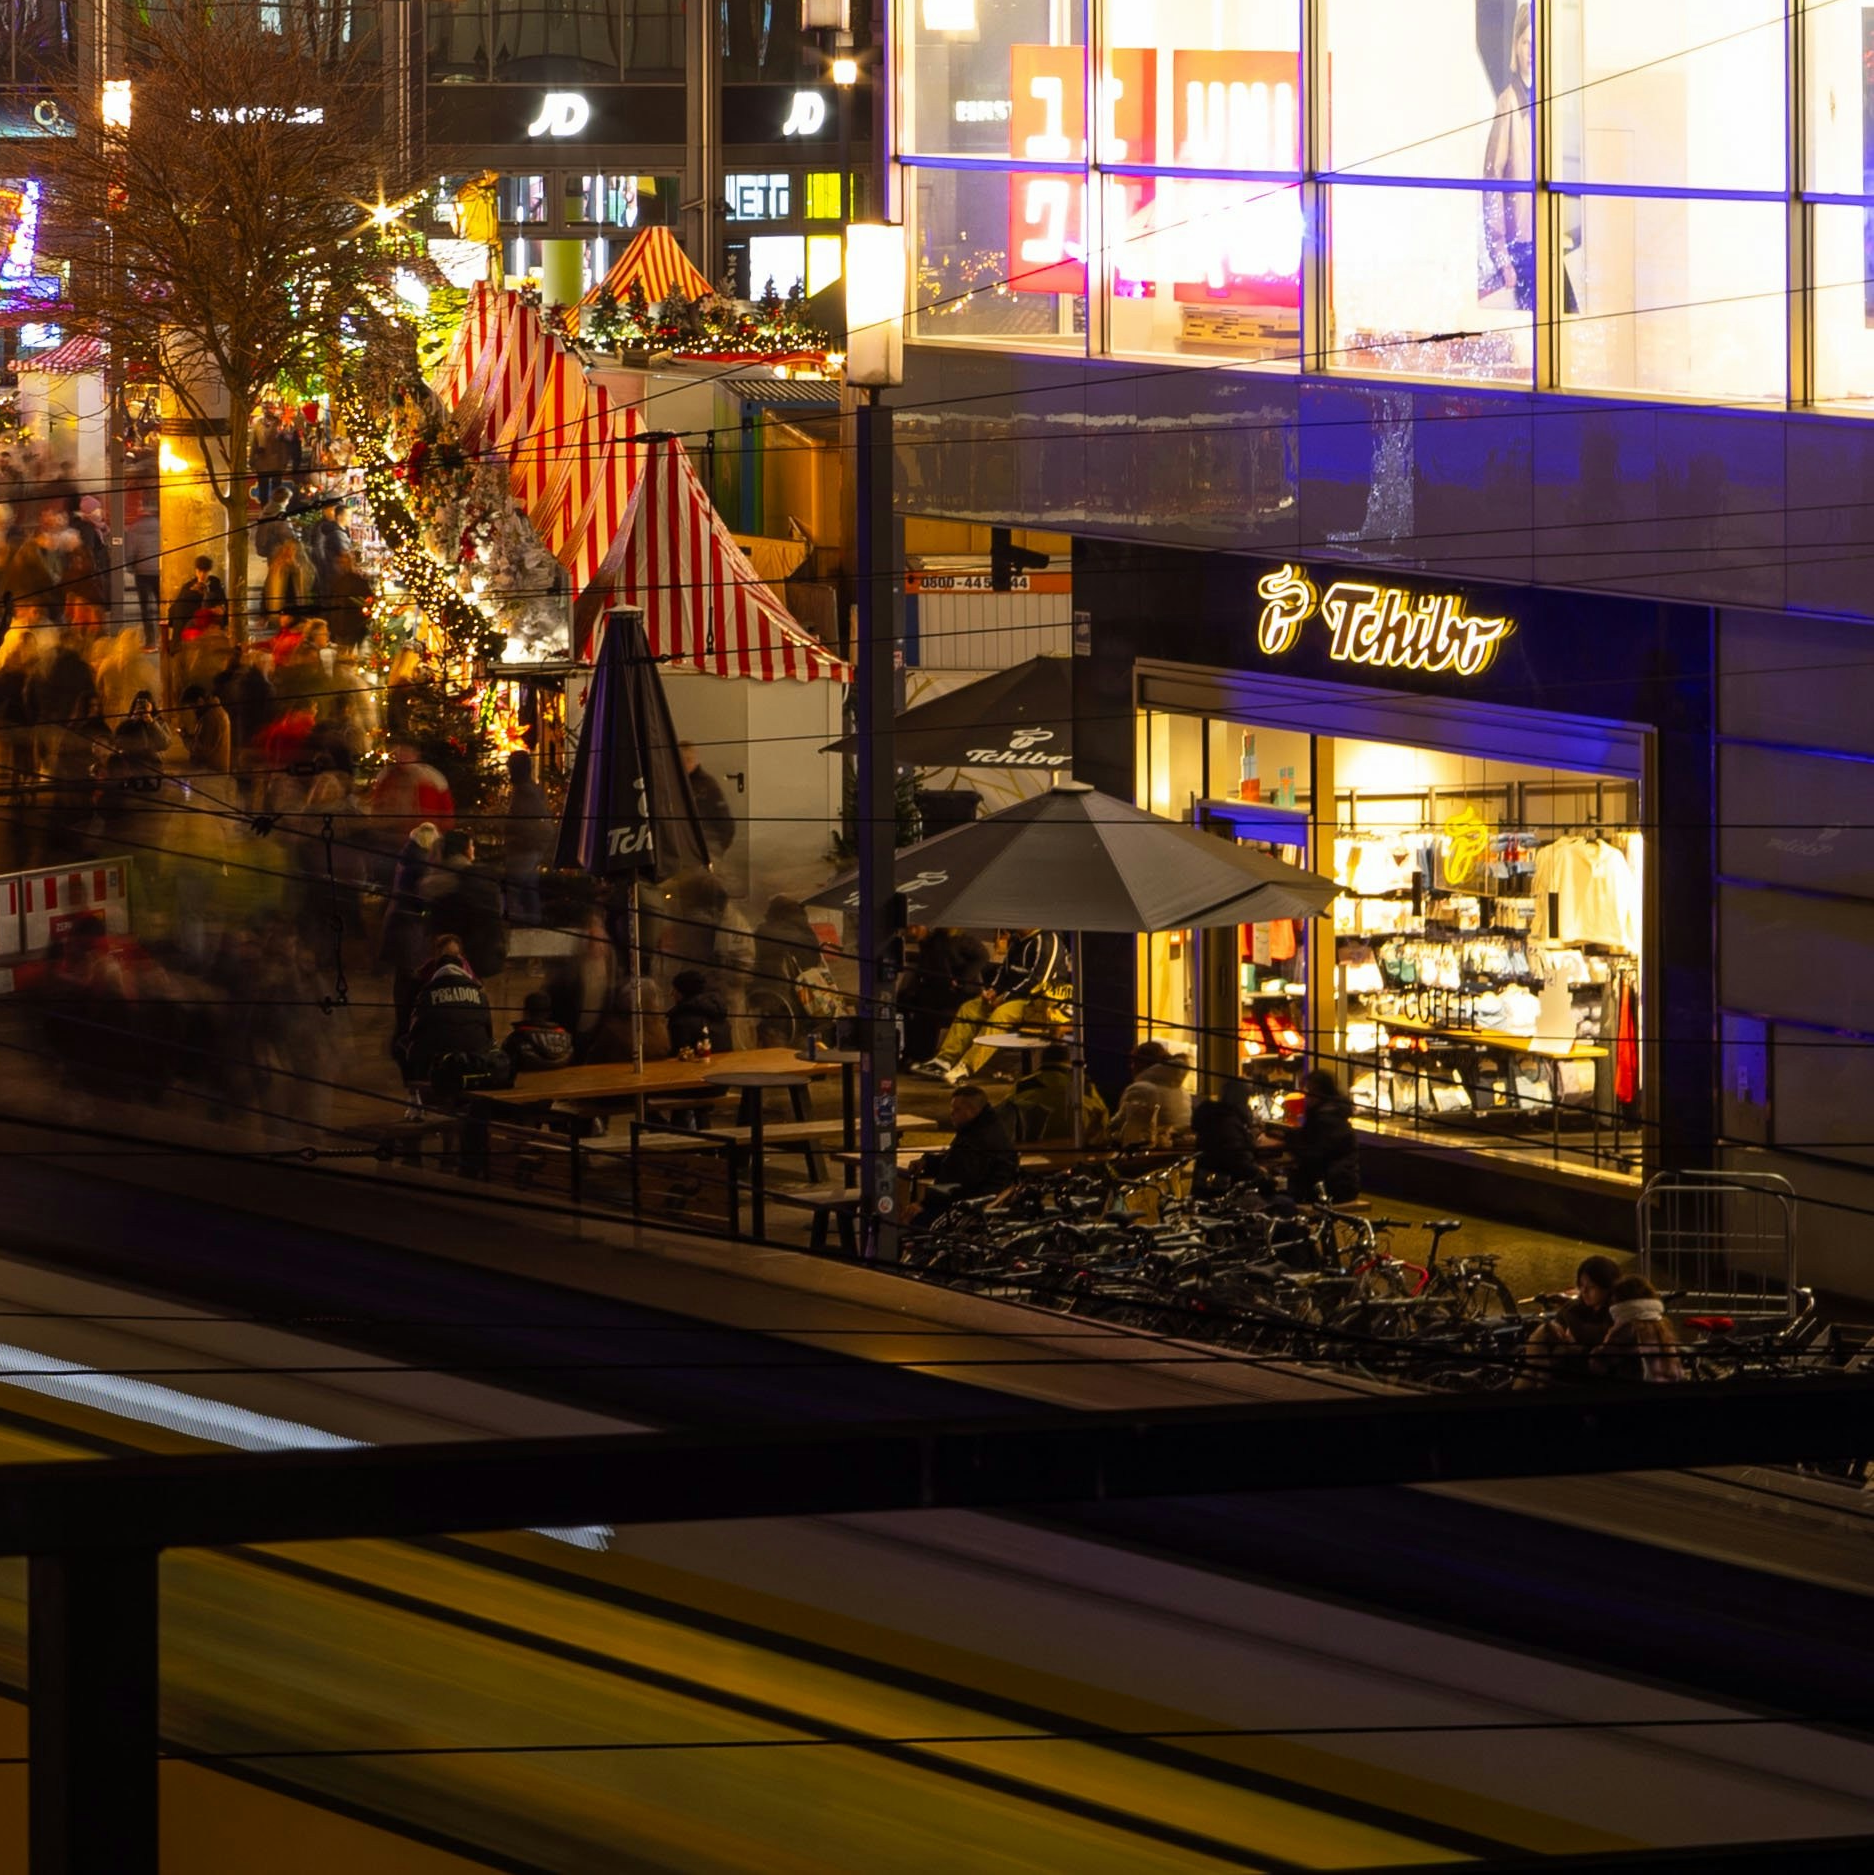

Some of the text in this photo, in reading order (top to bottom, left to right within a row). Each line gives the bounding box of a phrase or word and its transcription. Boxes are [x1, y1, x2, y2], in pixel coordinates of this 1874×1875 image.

[527, 92, 590, 138] JD
[782, 91, 826, 136] JD
[1321, 581, 1509, 676] Tchibo
[965, 748, 1072, 767] Tchibo
